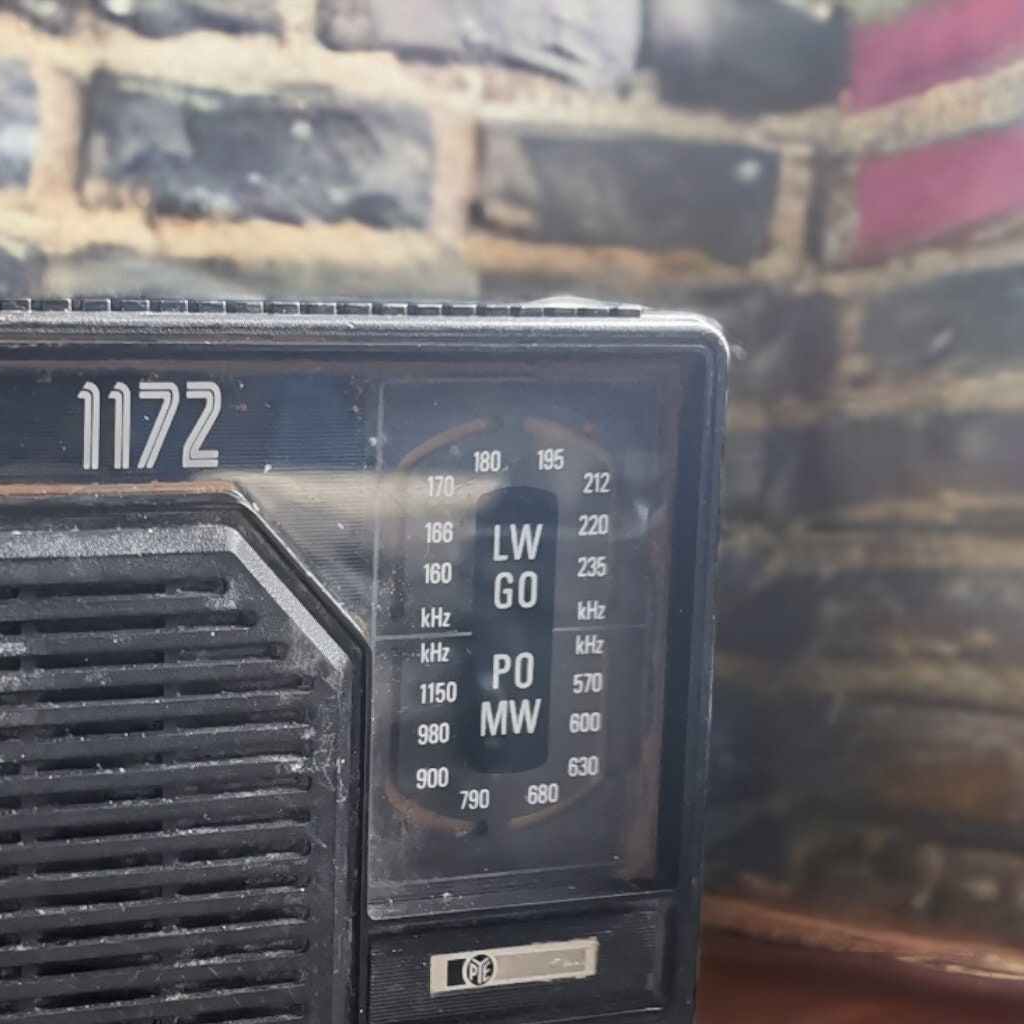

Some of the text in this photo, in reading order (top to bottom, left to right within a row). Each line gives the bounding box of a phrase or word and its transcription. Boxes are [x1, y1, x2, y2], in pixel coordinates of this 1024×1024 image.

[78, 381, 223, 470] 1172
[474, 451, 502, 472] 180
[537, 448, 565, 471] 195
[427, 475, 455, 497] 170
[583, 472, 611, 494] 212
[425, 522, 454, 543] 166
[578, 514, 609, 536] 220
[492, 523, 544, 561] LW
[423, 562, 452, 584] 160
[577, 556, 608, 578] 235
[494, 571, 538, 609] GO
[421, 607, 451, 628] kHz
[577, 600, 606, 621] kHz
[421, 642, 451, 663] kHz
[575, 635, 604, 655] kHz
[492, 652, 535, 690] PO
[420, 681, 458, 705] 1150
[573, 672, 603, 694] 570
[480, 698, 542, 737] MW
[569, 712, 602, 734] 600
[417, 722, 450, 746] 980
[568, 755, 600, 778] 630
[416, 767, 450, 790] 900
[460, 788, 490, 811] 790
[527, 783, 559, 805] 680
[468, 956, 494, 985] PYE
